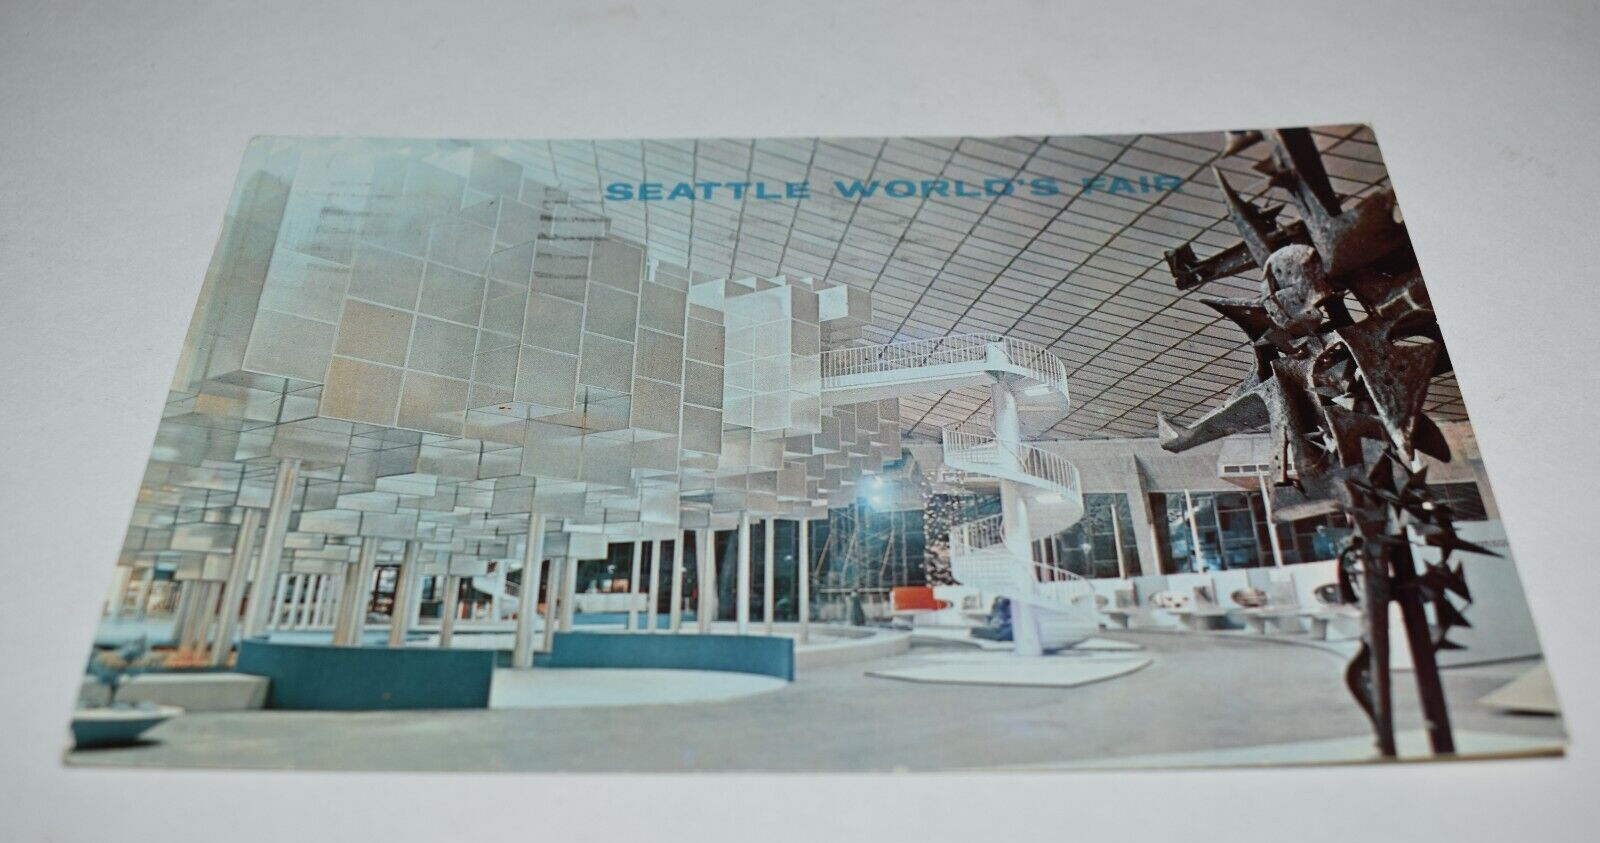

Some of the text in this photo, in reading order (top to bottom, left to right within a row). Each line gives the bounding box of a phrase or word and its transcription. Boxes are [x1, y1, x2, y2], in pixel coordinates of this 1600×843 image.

[605, 174, 1184, 201] SEATTLE WORLD'S FAIR
